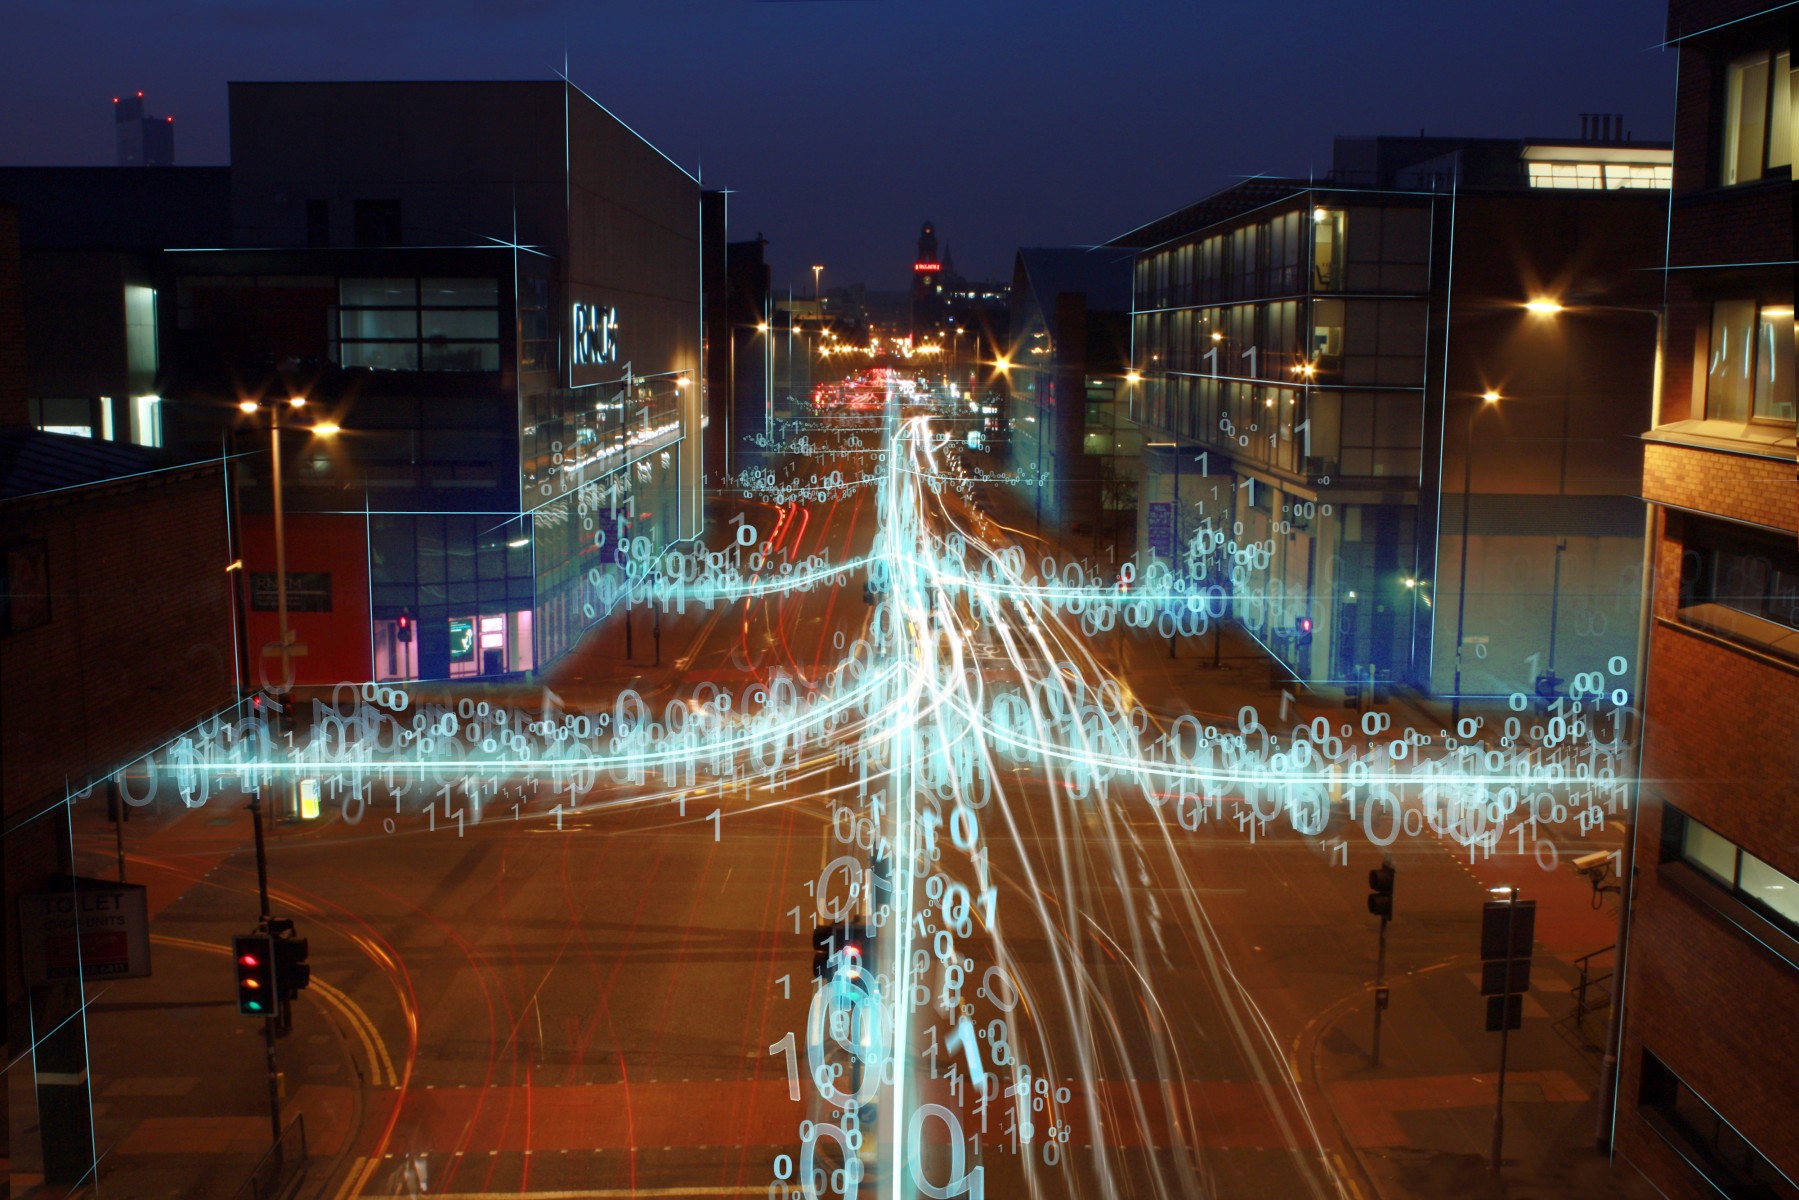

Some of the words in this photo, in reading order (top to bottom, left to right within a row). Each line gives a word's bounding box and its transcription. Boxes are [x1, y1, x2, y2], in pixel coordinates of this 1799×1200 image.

[42, 897, 73, 914] TO
[82, 893, 124, 911] LET
[86, 916, 126, 928] UNITS
